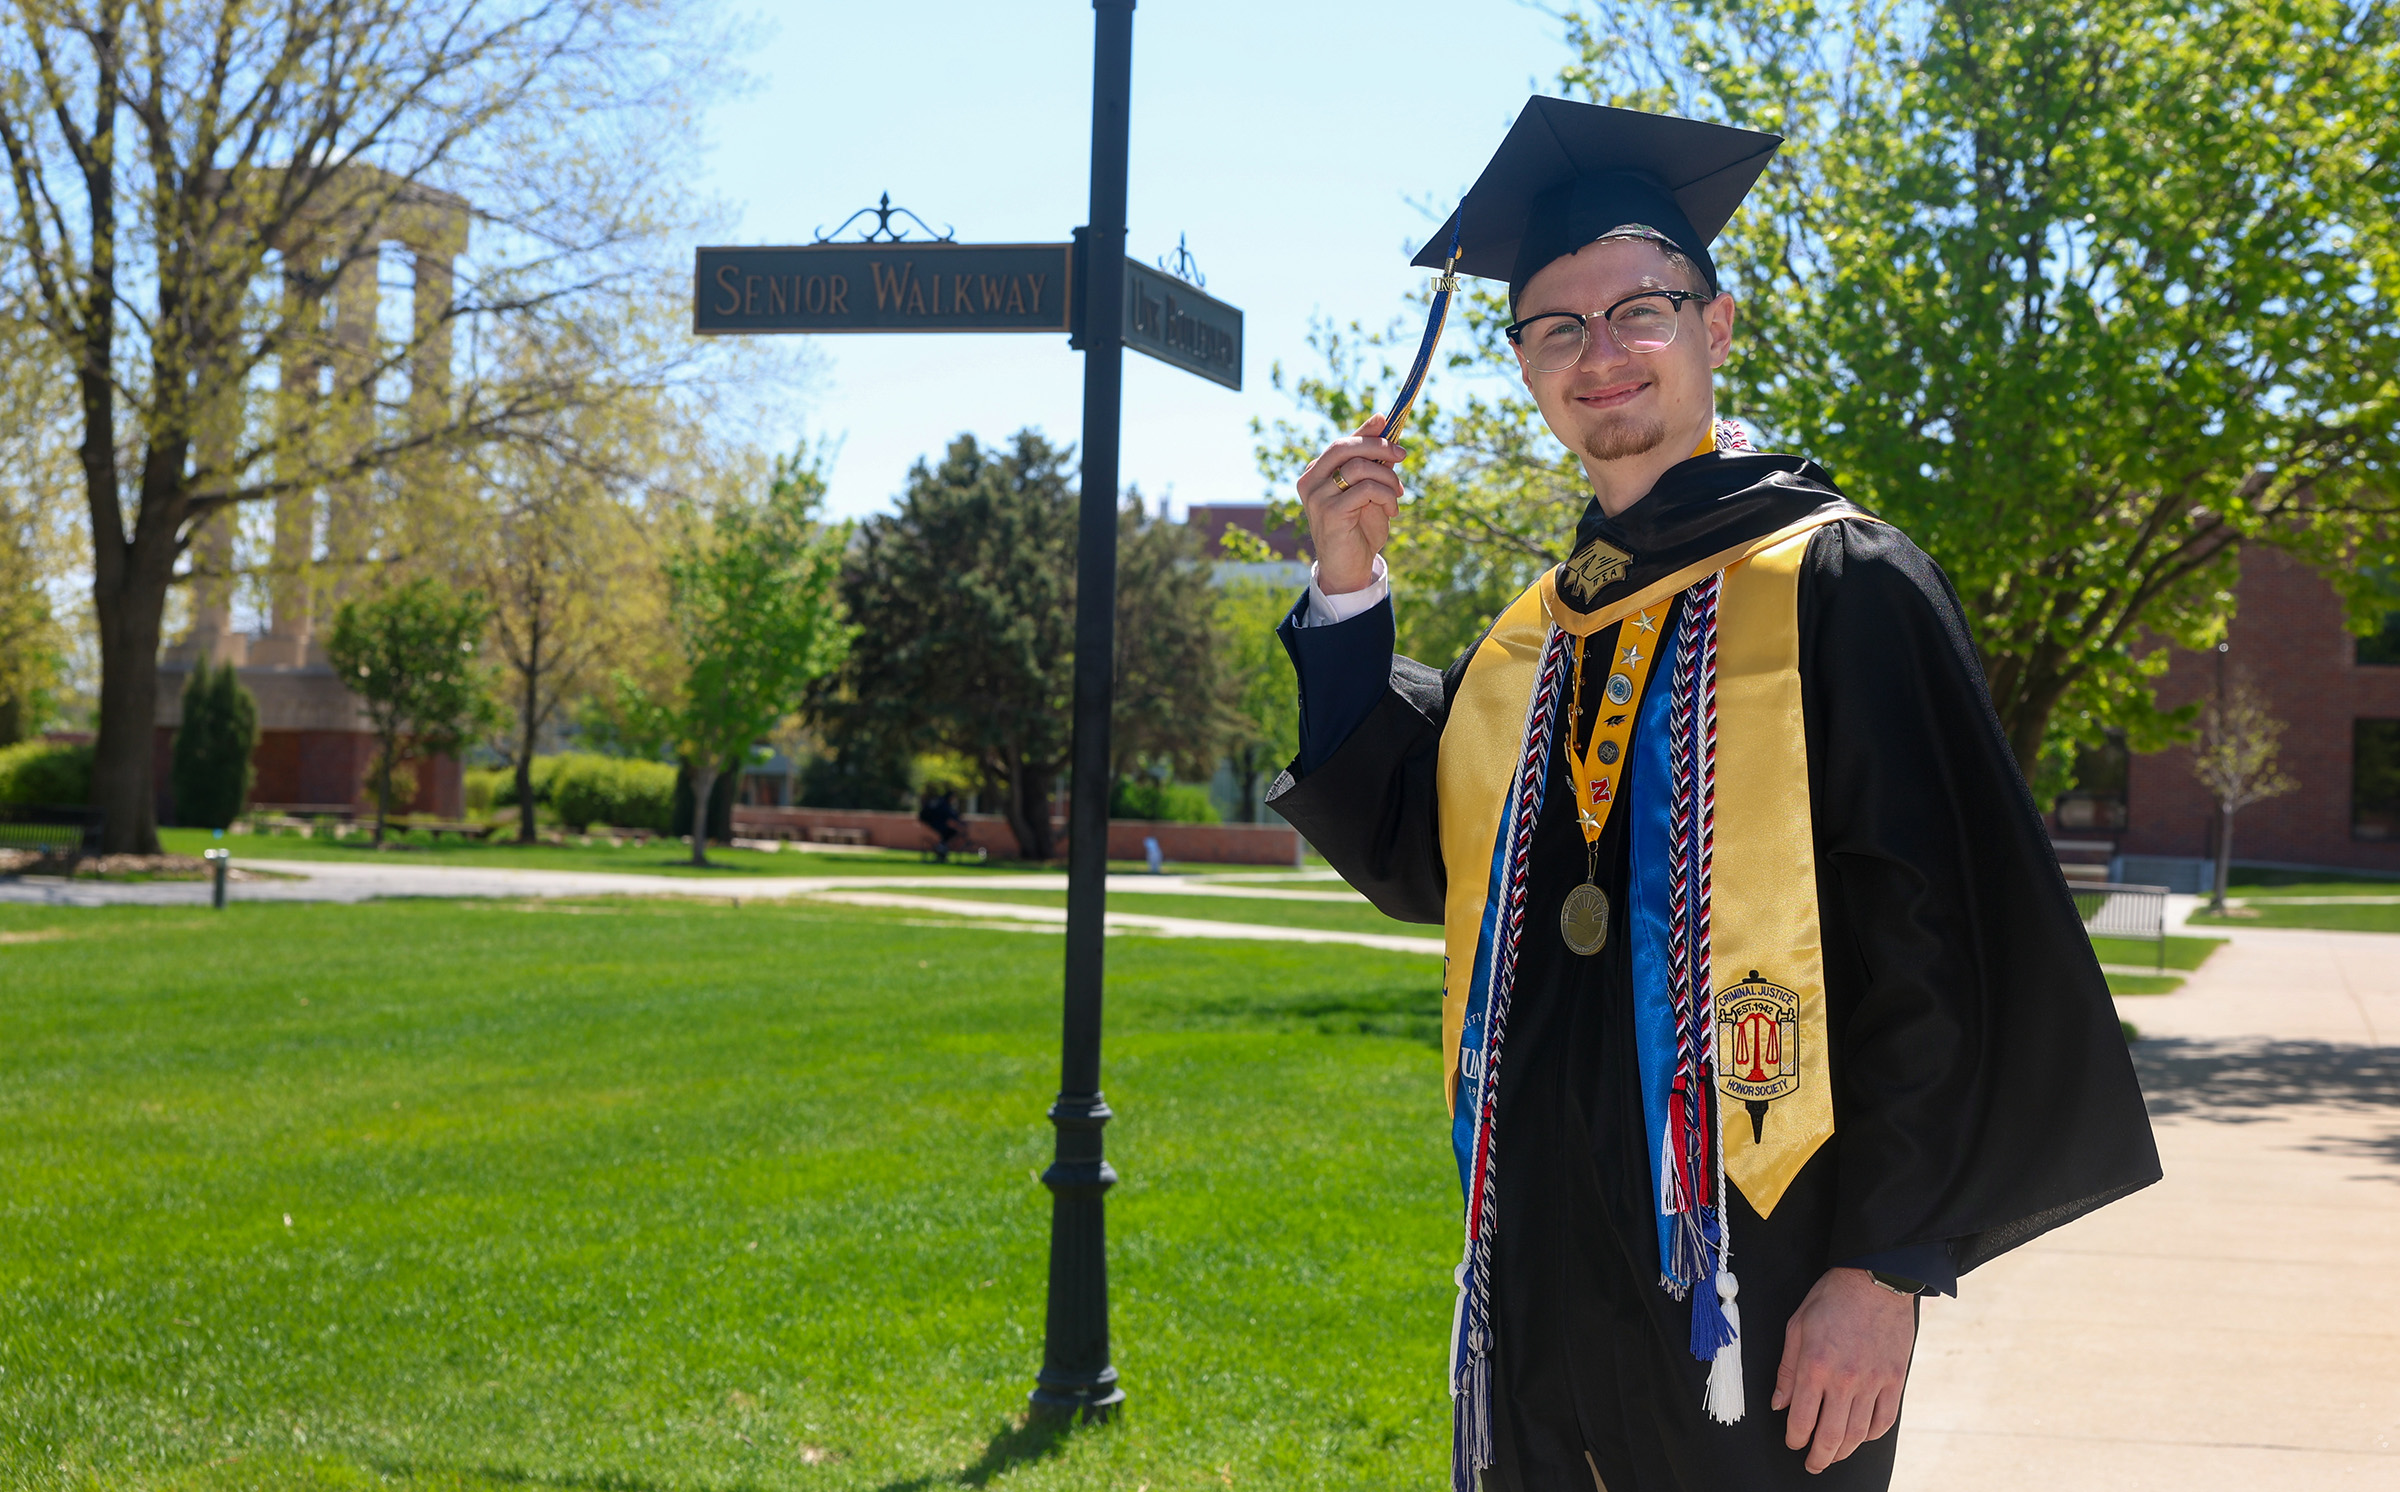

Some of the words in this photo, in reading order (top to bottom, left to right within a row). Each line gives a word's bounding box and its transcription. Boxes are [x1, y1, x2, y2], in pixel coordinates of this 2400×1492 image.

[714, 265, 849, 316] SENIOR
[870, 261, 1046, 315] WALKWAY
[1430, 276, 1462, 292] UNK
[1589, 776, 1612, 805] N
[1718, 986, 1757, 1007] CRIMINAL
[1757, 986, 1796, 1007] JUSTICE
[1726, 1079, 1755, 1096] HONOR
[1755, 1078, 1789, 1096] SOCIETY
